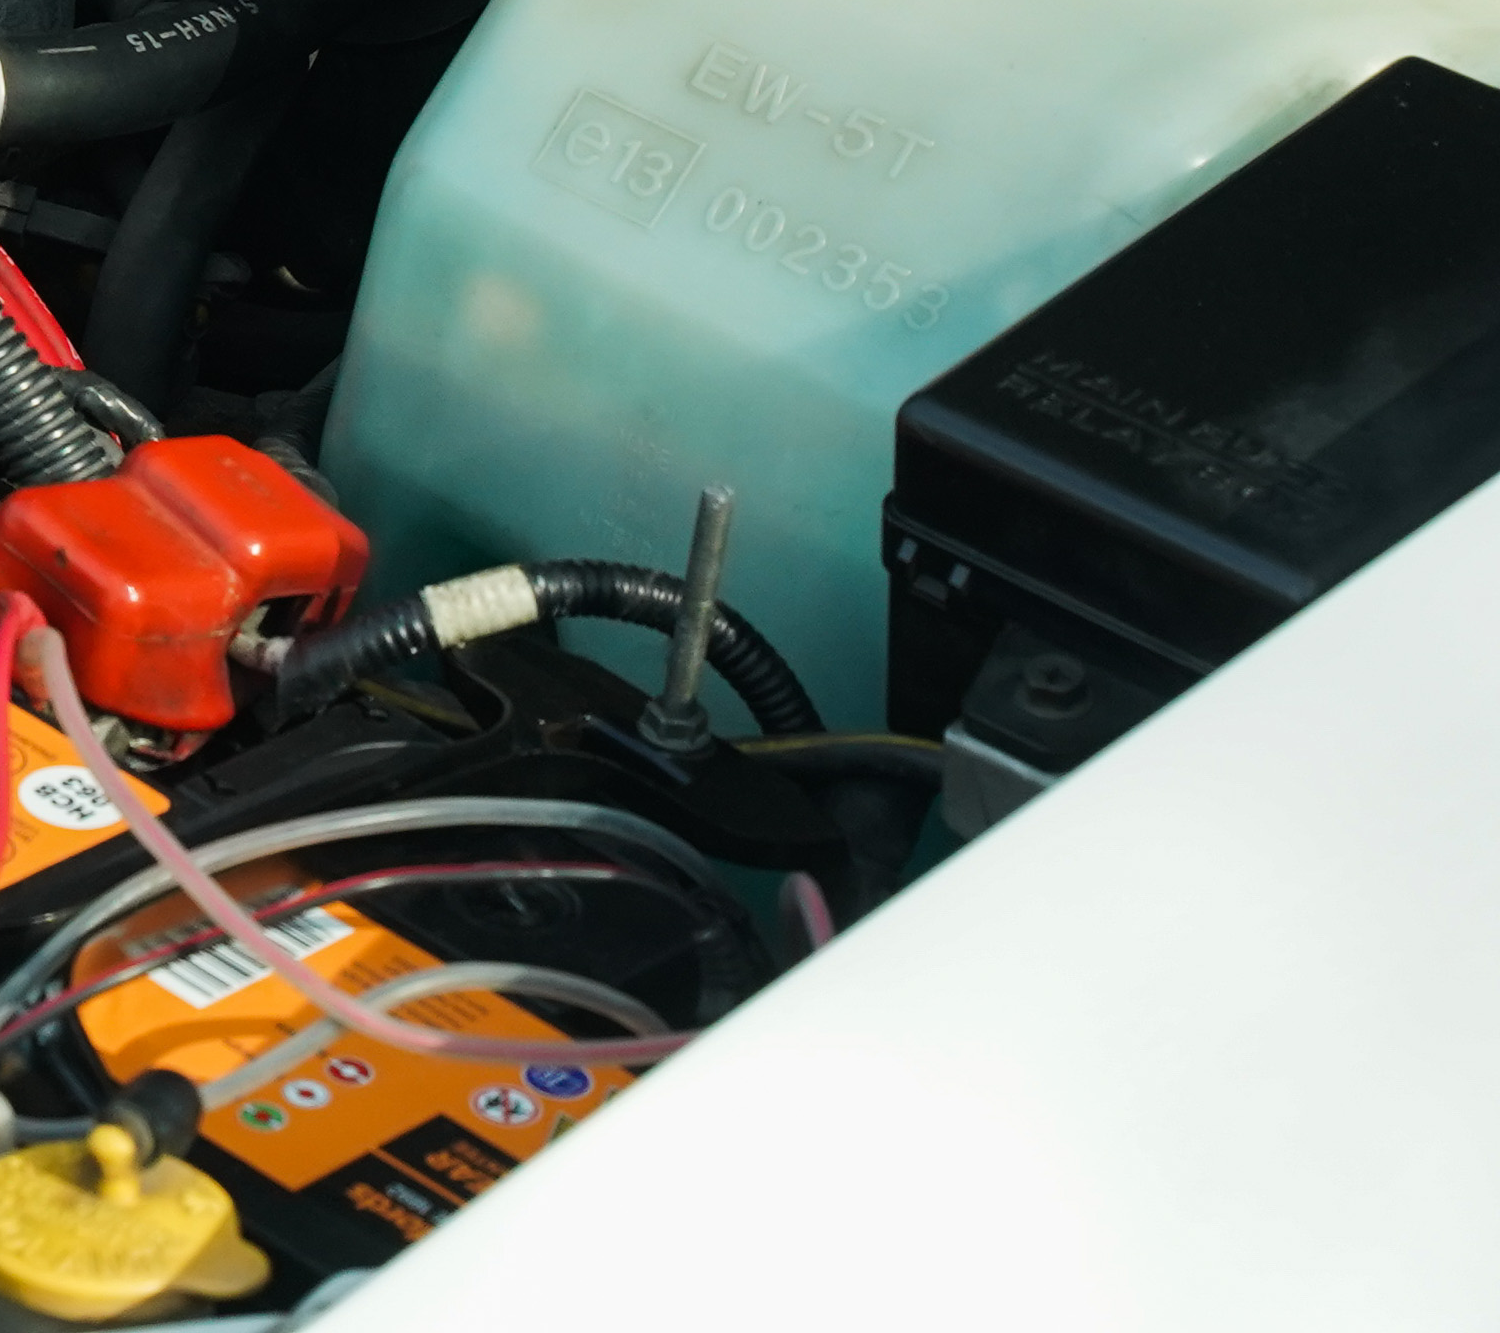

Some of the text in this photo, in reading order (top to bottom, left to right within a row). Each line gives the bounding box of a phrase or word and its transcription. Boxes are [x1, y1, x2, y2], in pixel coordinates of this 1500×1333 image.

[690, 40, 936, 180] EW-5T
[565, 120, 674, 199] e13
[30, 783, 96, 821] HCB
